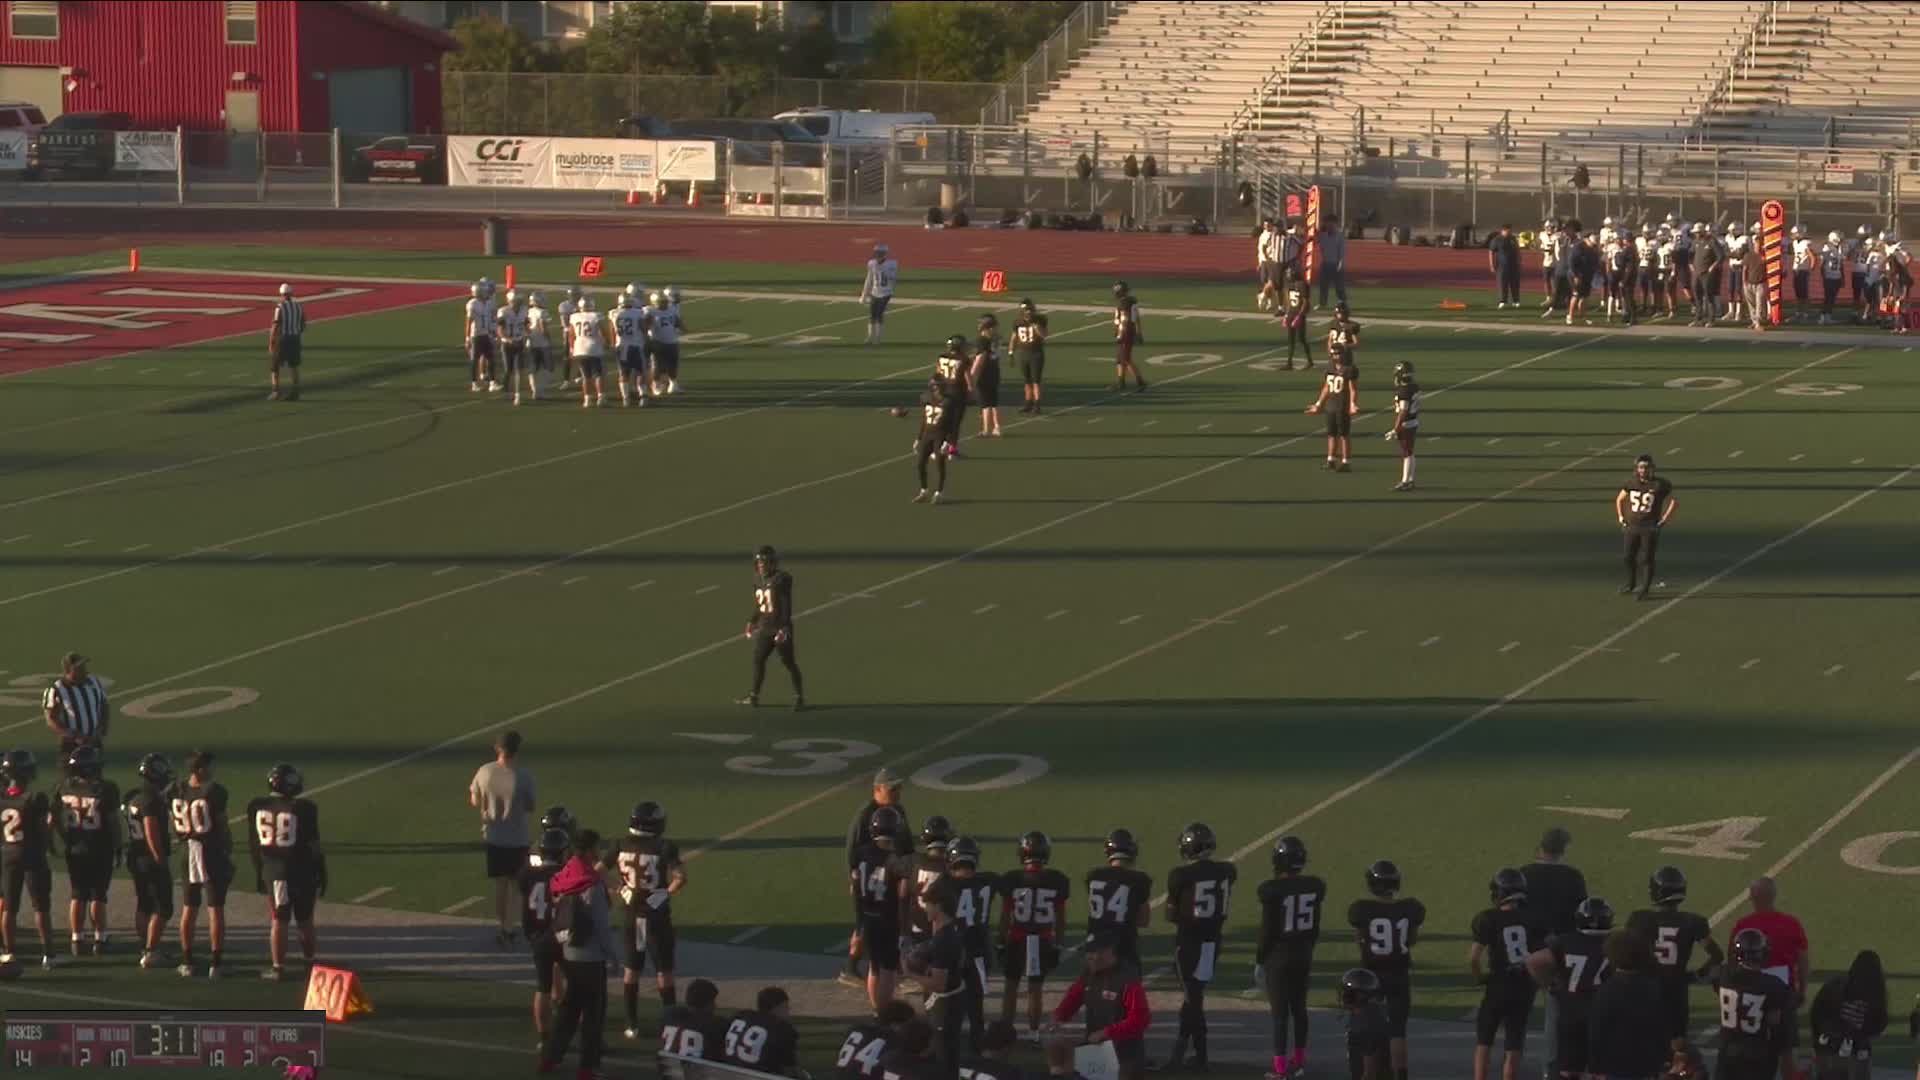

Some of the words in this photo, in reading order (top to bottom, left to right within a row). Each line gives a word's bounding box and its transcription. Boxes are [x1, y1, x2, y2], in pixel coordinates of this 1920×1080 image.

[585, 259, 599, 273] G
[985, 271, 1001, 287] 10
[1017, 325, 1034, 342] 61
[938, 356, 962, 379] 57
[1327, 374, 1345, 393] 50
[924, 404, 943, 423] 27
[1629, 489, 1655, 511] 59
[755, 588, 773, 612] 21
[171, 799, 212, 833] 90
[255, 809, 297, 846] 68
[617, 852, 660, 889] 53
[859, 861, 888, 901] 14
[956, 886, 991, 926] 41
[1194, 878, 1231, 918] 51
[1281, 893, 1318, 932] 15
[1369, 918, 1409, 955] 91
[1503, 925, 1529, 964] 8
[1654, 926, 1679, 965] 5
[1719, 987, 1767, 1034] 83
[837, 1031, 887, 1075] 64
